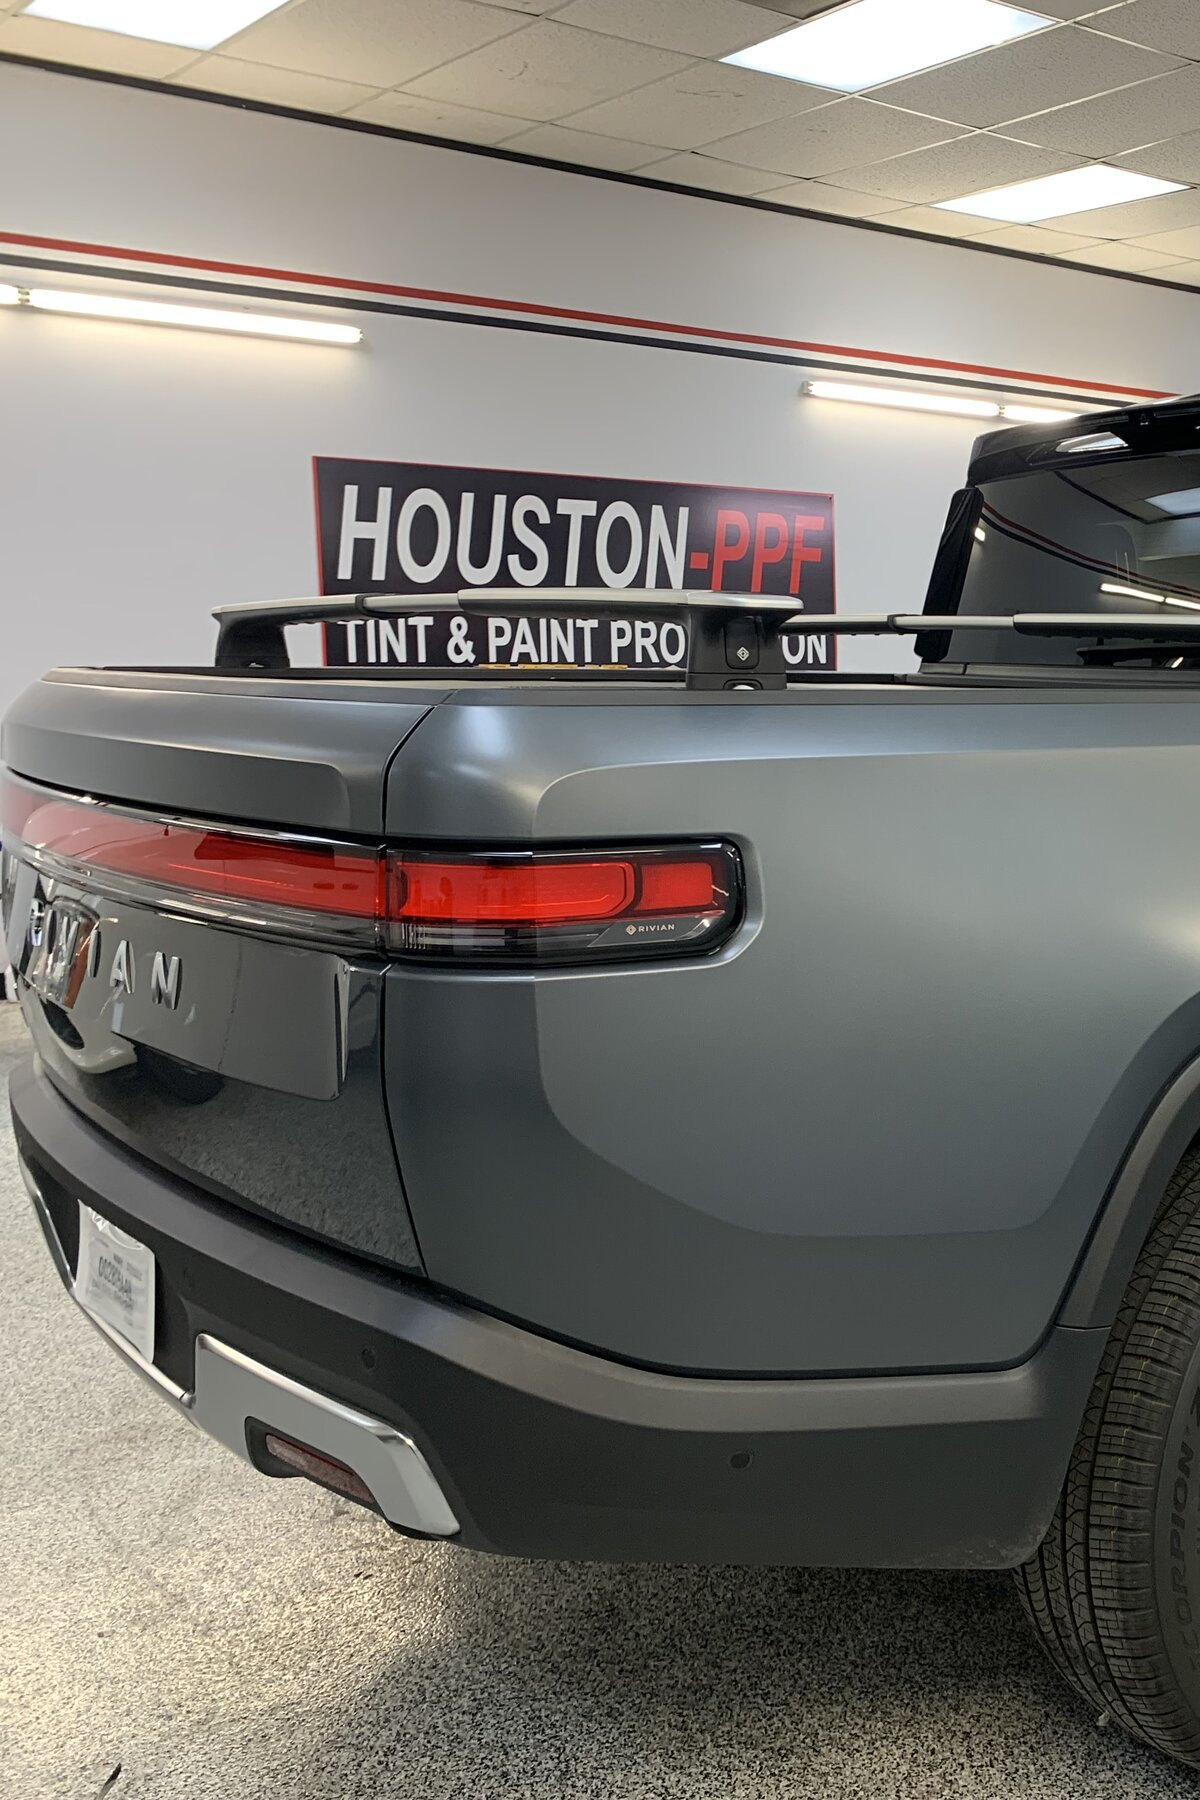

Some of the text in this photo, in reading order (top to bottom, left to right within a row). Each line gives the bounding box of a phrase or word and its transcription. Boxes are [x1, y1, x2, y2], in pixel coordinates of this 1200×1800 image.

[337, 484, 825, 595] HOUSTON-PPF
[338, 616, 434, 664] TINT
[445, 616, 476, 664] &
[488, 617, 598, 664] PAINT
[638, 924, 675, 932] RIVIAN
